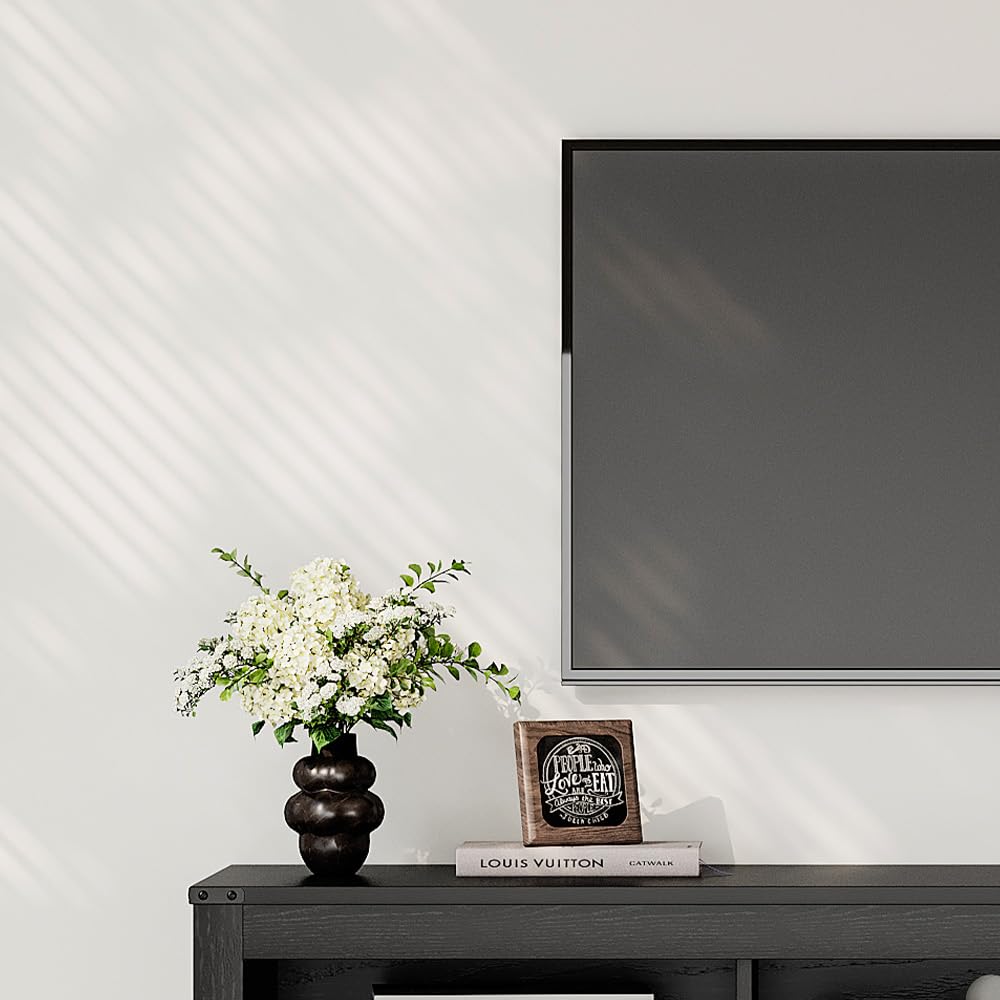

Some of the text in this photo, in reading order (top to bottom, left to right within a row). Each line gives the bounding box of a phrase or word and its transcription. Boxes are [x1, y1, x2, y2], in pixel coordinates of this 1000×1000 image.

[553, 754, 612, 773] PEOPLE who
[541, 771, 582, 795] Love
[592, 773, 616, 793] EAT
[480, 858, 604, 868] LOUIS VUITTON
